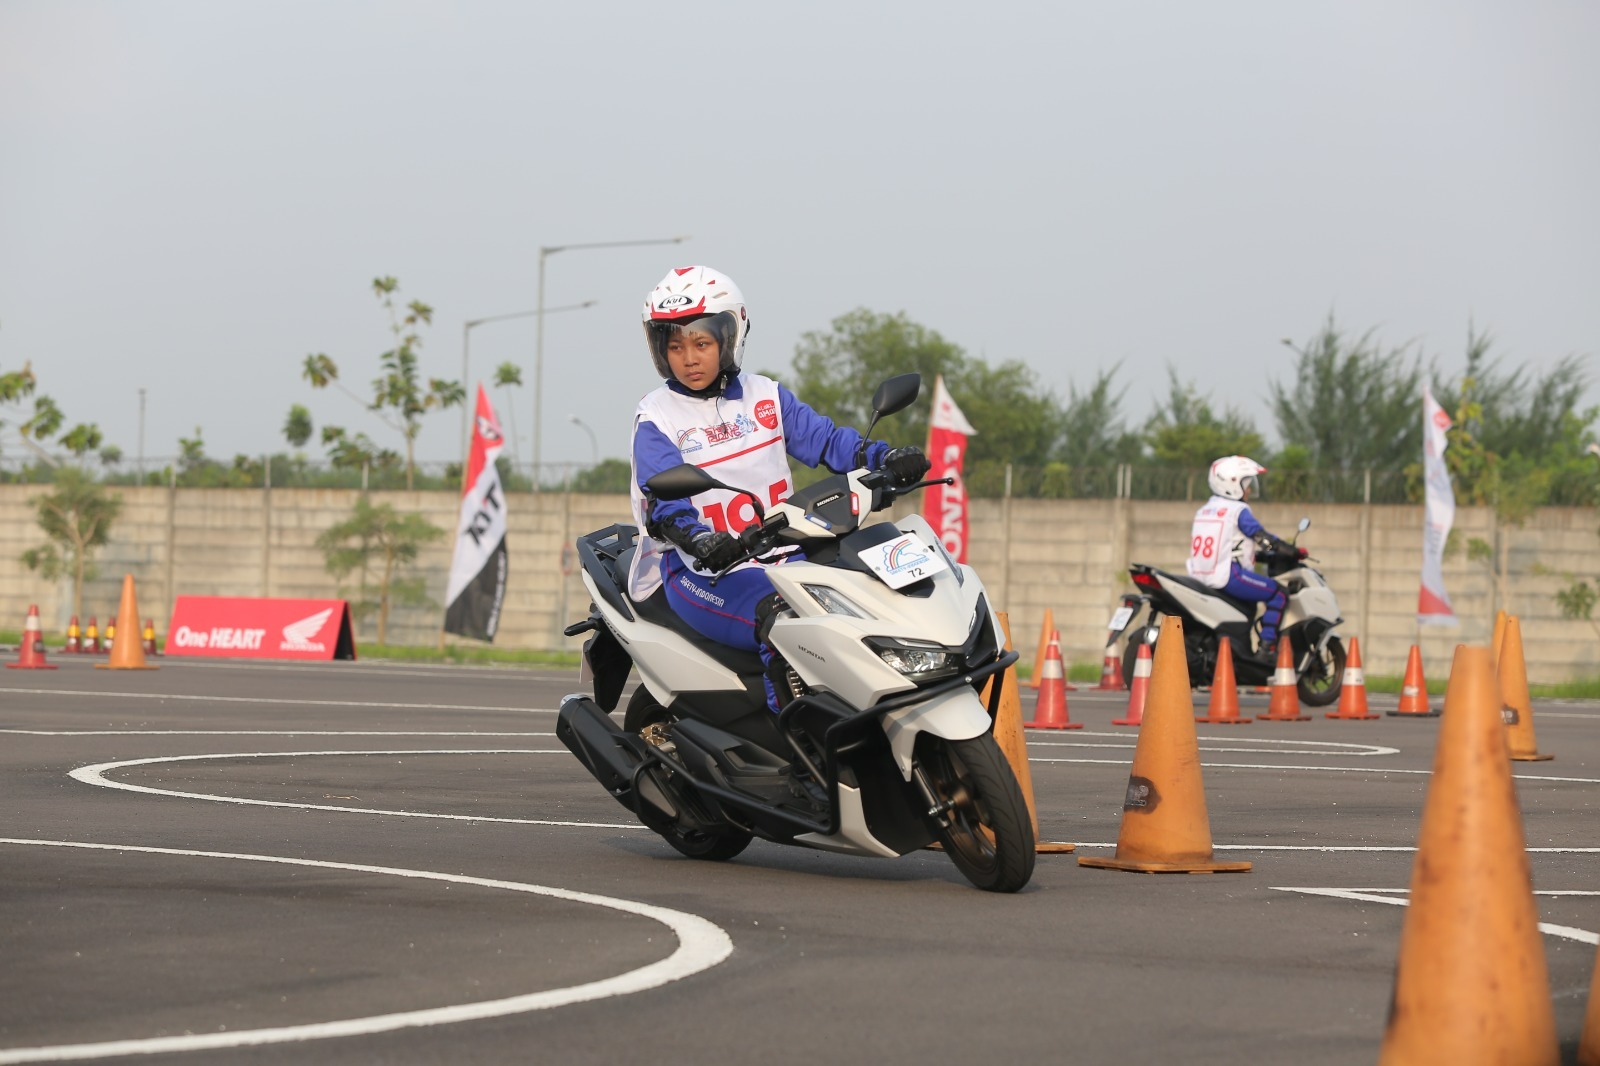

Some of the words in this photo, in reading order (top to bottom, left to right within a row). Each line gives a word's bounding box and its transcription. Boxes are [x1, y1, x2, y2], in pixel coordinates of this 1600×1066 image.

[816, 494, 840, 507] HONDA
[907, 567, 925, 578] 72
[174, 625, 209, 648] One
[209, 626, 267, 650] HEART
[279, 640, 326, 653] HONDA
[798, 644, 826, 662] HONDA
